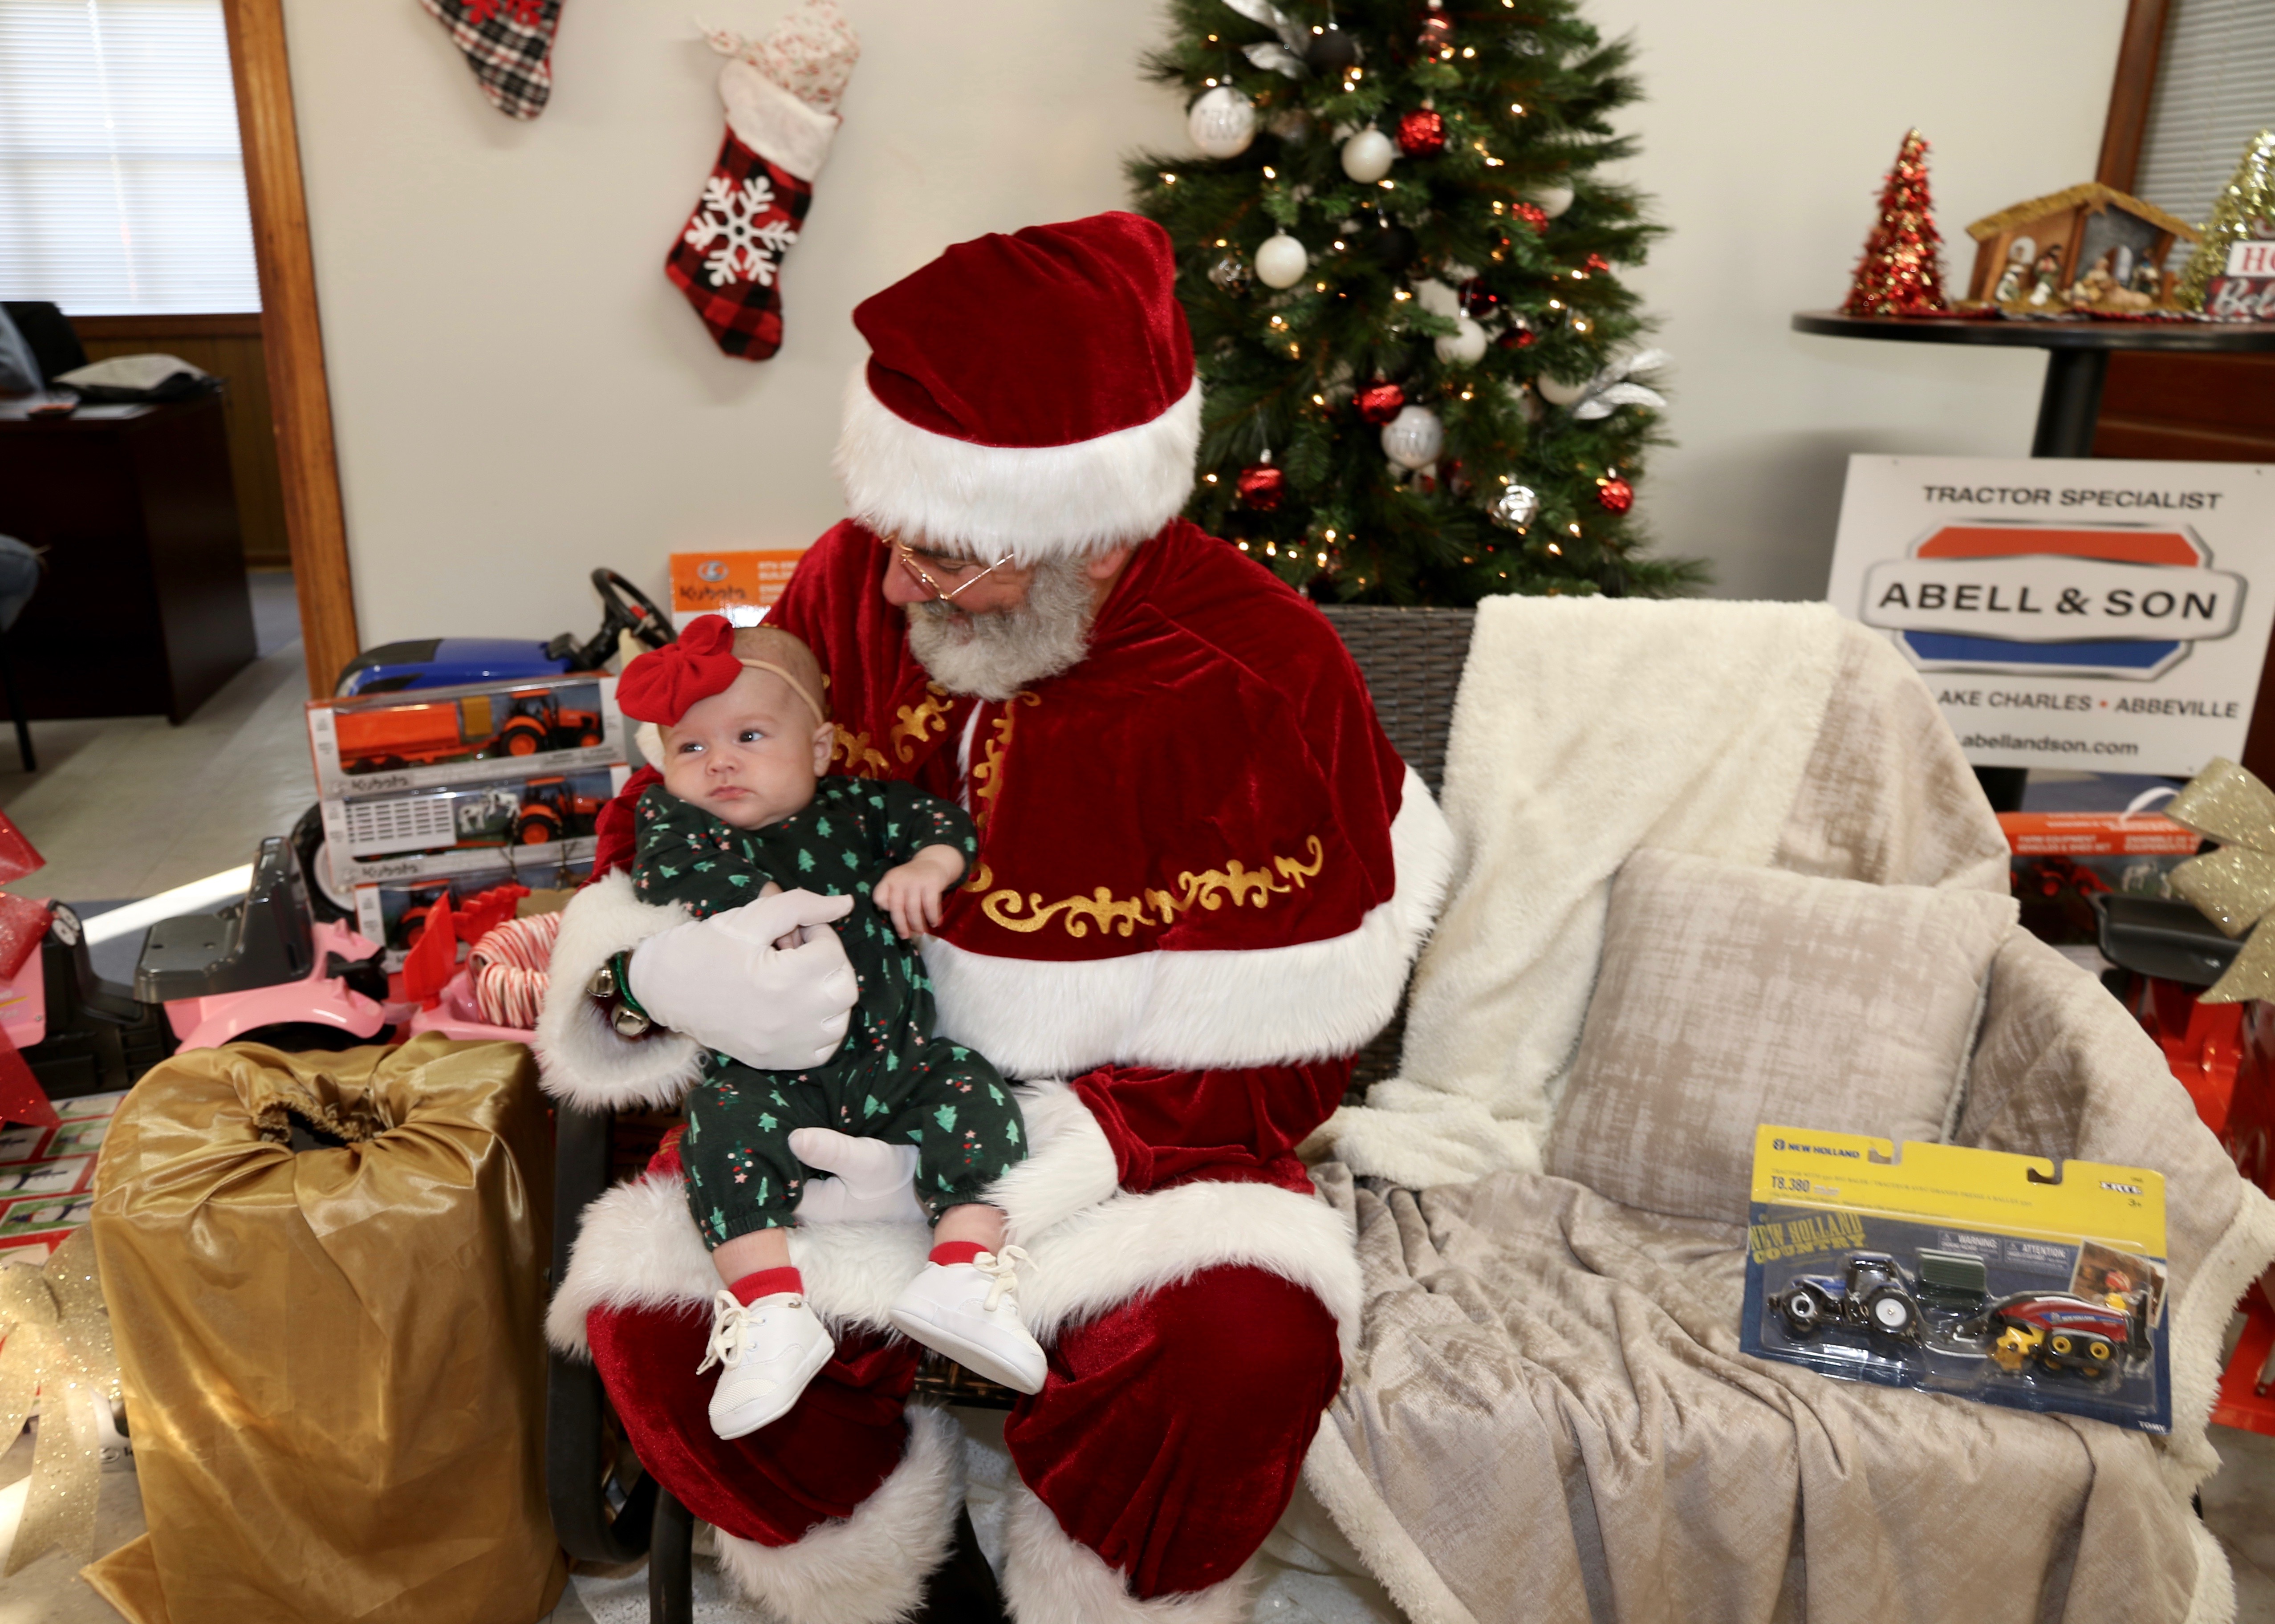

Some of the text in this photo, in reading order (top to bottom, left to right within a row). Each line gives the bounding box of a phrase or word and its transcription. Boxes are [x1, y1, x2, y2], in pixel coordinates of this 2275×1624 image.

[1924, 485, 2222, 509] TRACTOR SPECIALIST
[679, 585, 746, 601] Kubota
[1878, 582, 2217, 620] ABELL & SON
[1931, 689, 2239, 718] AKE CHARLES ABBEVILLE
[1788, 1142, 1860, 1158] NEW HOLLAND
[1771, 1175, 1810, 1192] T8.380
[1749, 1211, 1864, 1251] NEW HOLLAND
[1958, 1234, 1998, 1248] WARNING:
[1753, 1232, 1866, 1265] COUNTRY
[2022, 1243, 2066, 1259] ATTENTION:
